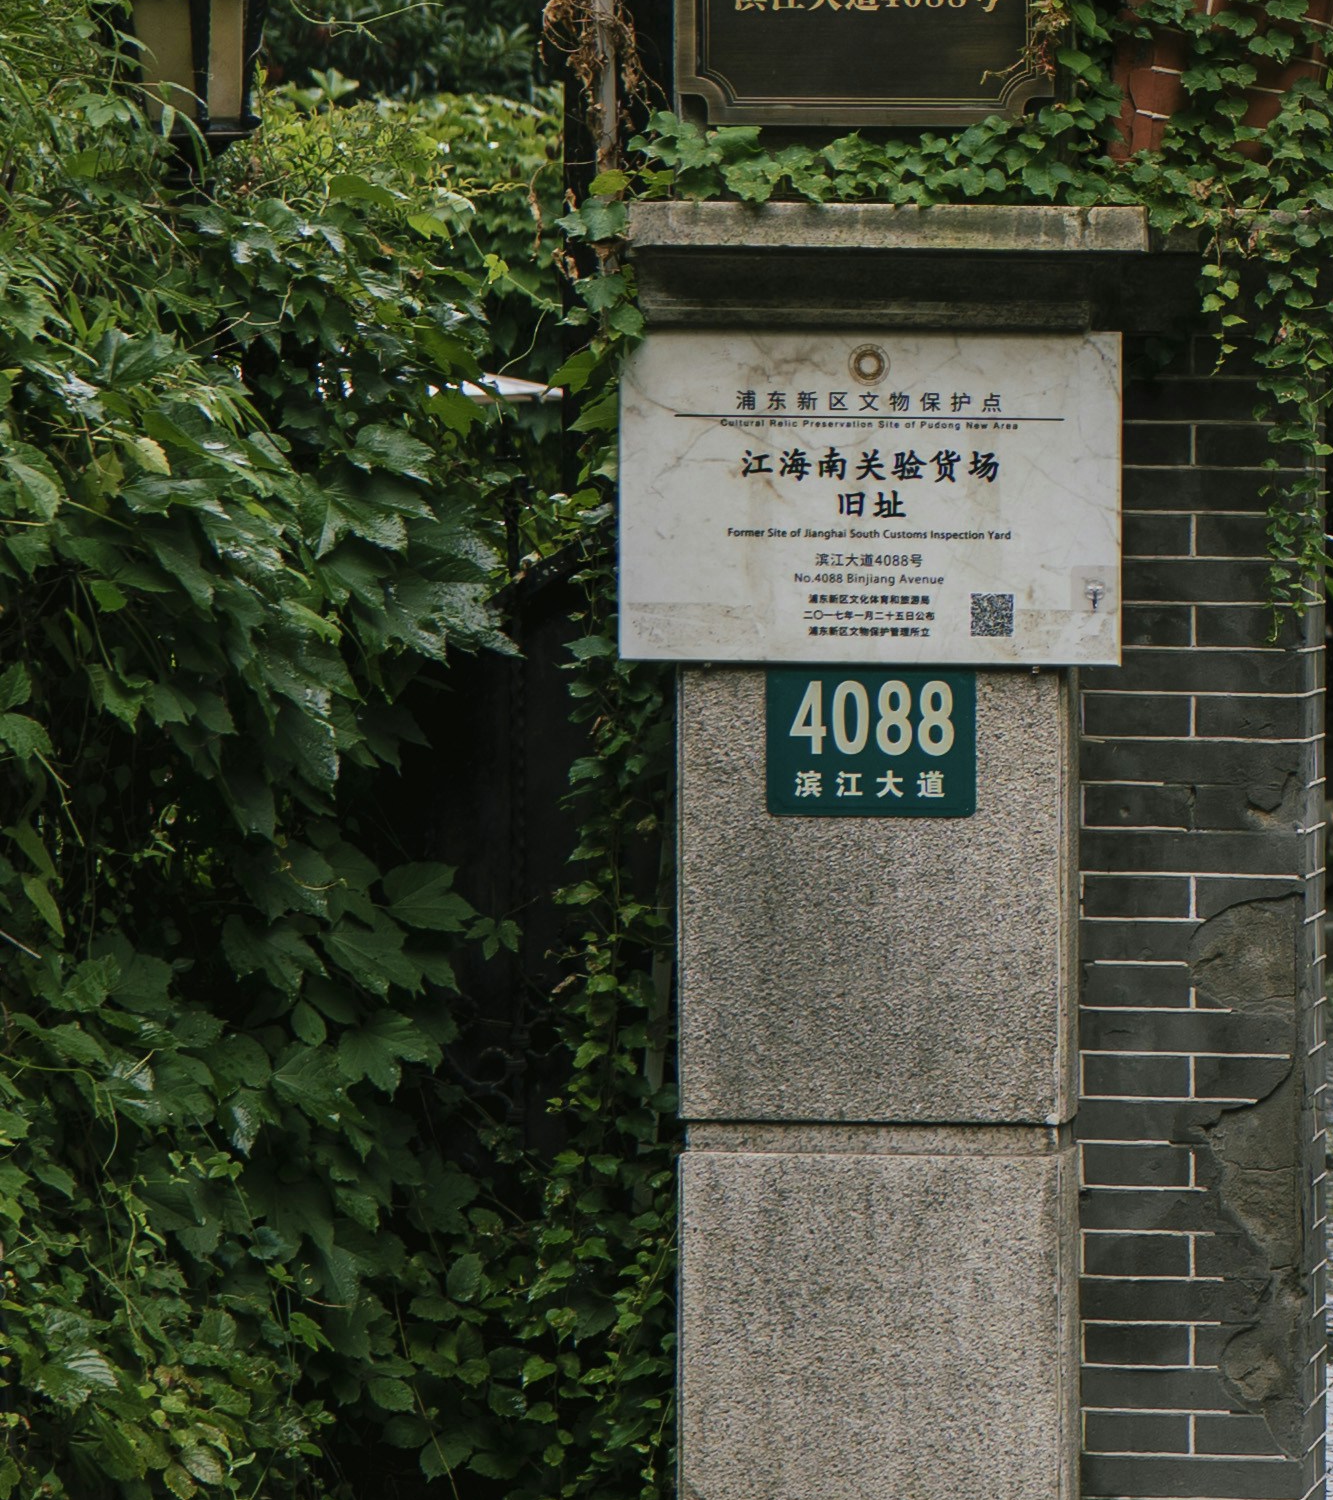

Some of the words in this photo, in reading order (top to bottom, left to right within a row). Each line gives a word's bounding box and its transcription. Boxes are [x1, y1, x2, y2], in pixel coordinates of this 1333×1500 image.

[736, 390, 1001, 412] 浦东新区文物保护点
[720, 418, 765, 427] Cultural
[769, 419, 798, 428] Relic
[802, 420, 873, 428] Preservation
[878, 420, 900, 429] Site
[905, 420, 915, 429] of
[920, 421, 961, 431] Pudong
[966, 421, 988, 430] New
[993, 422, 1019, 430] Area
[741, 447, 1000, 483] 江海南关验货场
[837, 490, 906, 518] 旧址
[728, 528, 765, 538] Former
[767, 528, 787, 538] Site
[790, 528, 801, 538] of
[804, 528, 847, 540] Jianghai
[850, 529, 880, 538] South
[883, 529, 927, 540] Customs
[930, 530, 985, 541] Inspection
[987, 530, 1012, 540] Yard
[815, 553, 923, 568] 滨江大道4088号
[794, 573, 843, 583] No.4088
[847, 573, 895, 586] Binjiang
[899, 574, 945, 584] Avenue
[789, 680, 955, 756] 4088
[794, 770, 945, 798] 滨江大道
